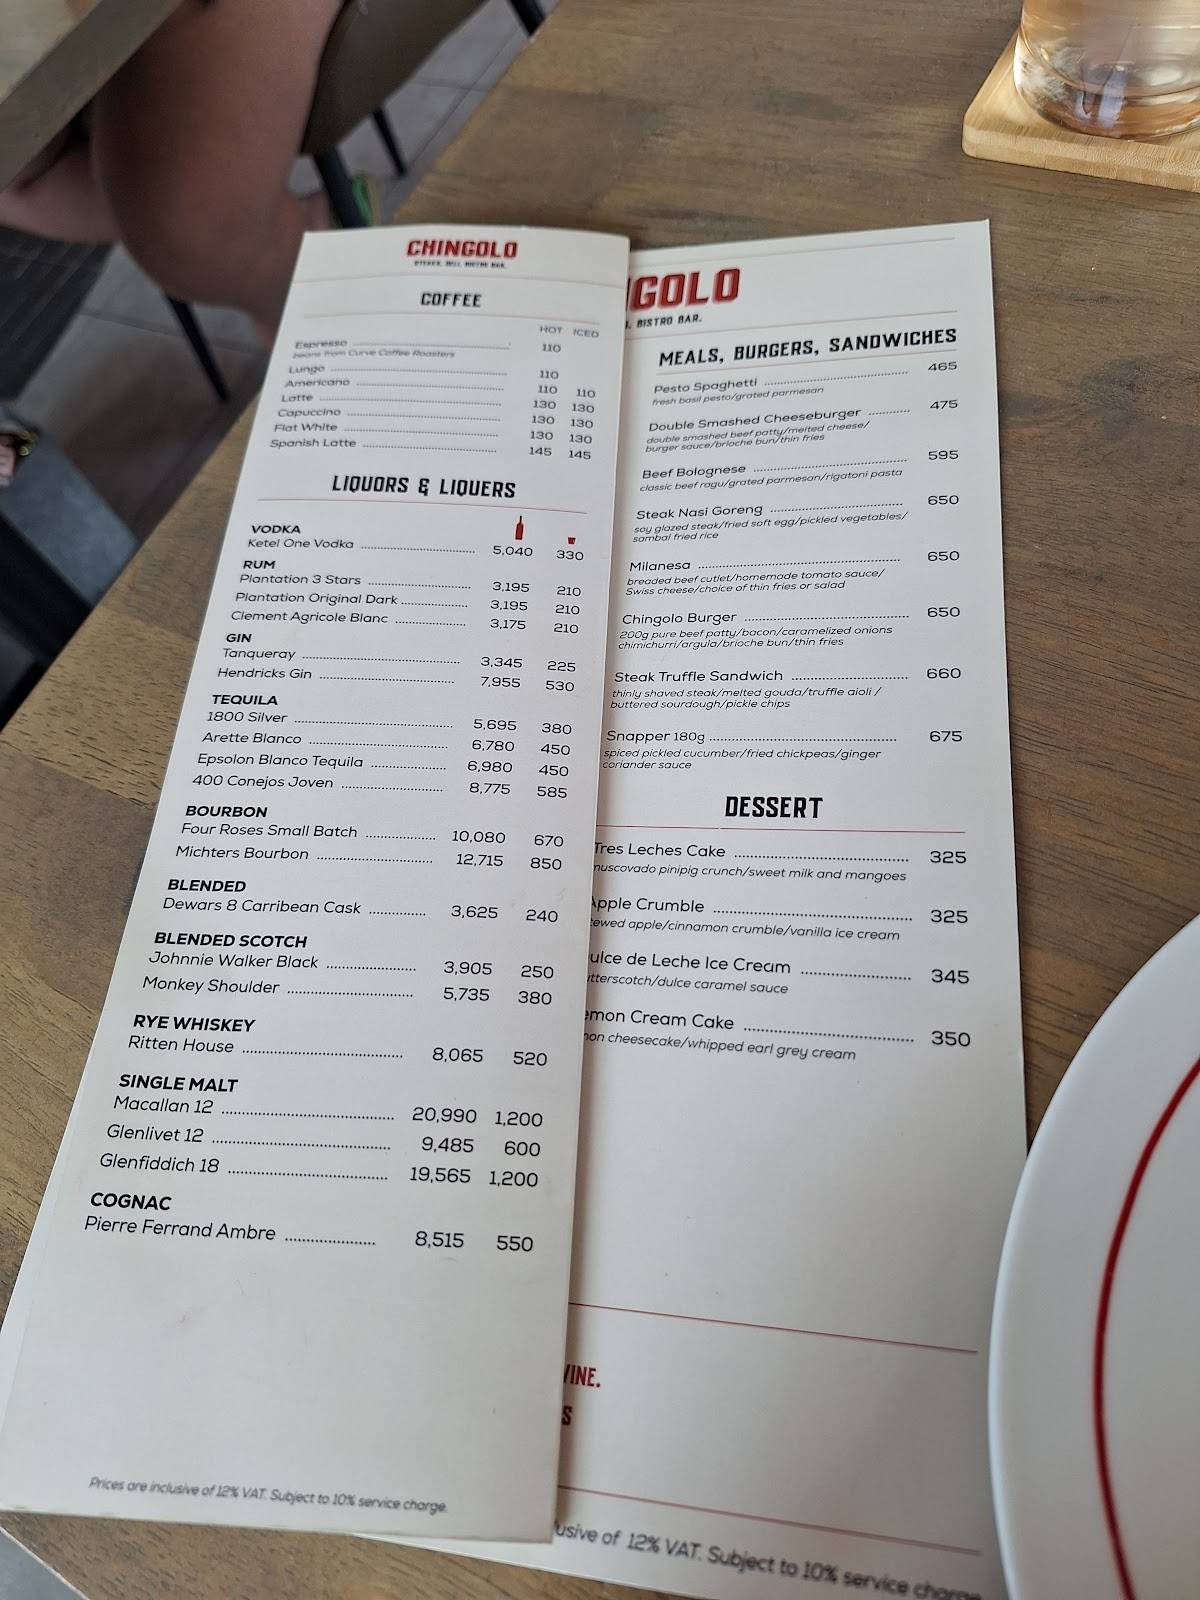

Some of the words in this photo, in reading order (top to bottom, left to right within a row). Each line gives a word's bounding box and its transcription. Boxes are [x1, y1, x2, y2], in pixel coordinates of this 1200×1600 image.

[406, 239, 519, 260] CHINGOLO
[420, 292, 482, 308] COFFEE
[625, 266, 741, 313] GOLO
[538, 324, 564, 335] HOT
[572, 327, 600, 339] ICED
[635, 315, 674, 329] BISTRO
[677, 313, 703, 325] BAR.
[294, 339, 349, 351] Espresso
[541, 343, 562, 354] 110
[658, 347, 725, 367] MEALS,
[733, 339, 820, 361] BURGERS,
[828, 327, 957, 353] SANDWICHES
[287, 364, 326, 376] Lungo
[539, 369, 560, 380] 110
[653, 384, 691, 395] Pesto
[692, 377, 758, 394] Spaghetti
[927, 360, 958, 372] 465
[276, 407, 342, 419] Capuccino
[531, 414, 556, 425] 130
[570, 418, 594, 430] 130
[648, 420, 695, 433] Double
[697, 415, 761, 429] Smashed
[763, 409, 863, 425] Cheeseburger
[929, 398, 959, 410] 475
[273, 423, 299, 433] Flat
[300, 422, 339, 432] White
[530, 429, 555, 441] 130
[568, 433, 593, 445] 130
[641, 468, 675, 480] Beef
[675, 465, 747, 479] Bolognese
[927, 449, 960, 461] 595
[331, 474, 410, 494] LIQUORS
[417, 477, 431, 497] &
[438, 477, 517, 499] LIQUERS
[635, 508, 675, 521] Steak
[677, 506, 709, 518] Nasi
[711, 505, 763, 518] Goreng
[927, 494, 960, 506] 650
[251, 524, 302, 535] VODKA
[631, 532, 673, 543] sambal
[672, 531, 699, 542] fried
[698, 530, 720, 540] rice
[247, 538, 281, 549] Ketel
[282, 538, 312, 549] One
[313, 538, 355, 550] Vodka
[492, 544, 534, 558] 5,040
[555, 549, 585, 562] 330
[629, 560, 692, 573] Milanesa
[926, 549, 960, 563] 650
[242, 559, 277, 570] RUM
[239, 573, 309, 585] Plantation
[311, 573, 323, 585] 3
[323, 574, 362, 586] Stars
[491, 580, 530, 594] 3,195
[556, 585, 582, 598] 210
[624, 586, 656, 597] Swiss
[656, 584, 734, 596] cheese/choice
[734, 582, 749, 593] of
[748, 582, 771, 592] thin
[772, 581, 797, 591] fries
[798, 582, 813, 591] or
[813, 579, 847, 590] salad
[621, 612, 684, 628] Chingolo
[687, 612, 738, 627] Burger
[926, 605, 961, 619] 650
[225, 632, 253, 644] GIN
[222, 647, 297, 662] Tanqueray
[480, 655, 523, 669] 3,345
[546, 660, 577, 673] 225
[613, 671, 656, 683] Steak
[658, 670, 706, 683] Truffle
[709, 669, 784, 682] Sandwich
[926, 667, 962, 680] 660
[211, 693, 279, 706] TEQUILA
[206, 710, 245, 723] 1800
[246, 710, 289, 724] Silver
[473, 718, 518, 732] 5,695
[541, 721, 573, 735] 380
[201, 731, 250, 744] Arette
[252, 731, 303, 745] Blanco
[471, 739, 515, 753] 6,780
[540, 743, 572, 757] 450
[605, 728, 671, 745] Snapper
[673, 731, 706, 746] 180g
[929, 729, 964, 743] 675
[601, 759, 658, 771] coriander
[657, 761, 693, 770] sauce
[185, 804, 269, 819] BOURBON
[724, 795, 824, 820] DESSERT
[180, 821, 218, 835] Four
[218, 822, 264, 837] Roses
[266, 823, 311, 837] Small
[312, 824, 358, 838] Batch
[451, 829, 506, 845] 10,080
[533, 834, 565, 848] 670
[594, 841, 625, 855] Tres
[627, 842, 683, 857] Leches
[686, 843, 727, 858] Cake
[929, 850, 968, 865] 325
[167, 878, 247, 893] BLENDED
[162, 897, 223, 912] Dewars
[225, 898, 238, 912] 8
[241, 898, 320, 914] Carribean
[323, 900, 362, 915] Cask
[450, 904, 499, 920] 3,625
[525, 908, 559, 924] 240
[635, 896, 705, 914] Crumble
[930, 908, 969, 925] 325
[153, 931, 236, 948] BLENDED
[238, 934, 309, 949] SCOTCH
[148, 950, 215, 967] Johnnie
[218, 953, 274, 968] Walker
[275, 954, 319, 969] Black
[443, 960, 493, 976] 3,905
[520, 964, 555, 980] 250
[132, 1013, 170, 1030] RYE
[172, 1016, 257, 1033] WHISKEY
[127, 1035, 179, 1052] Ritten
[182, 1037, 235, 1054] House
[431, 1046, 484, 1064] 8,065
[512, 1051, 548, 1067] 520
[117, 1073, 187, 1091] SINGLE
[187, 1077, 240, 1093] MALT
[112, 1094, 191, 1114] Macallan
[193, 1099, 215, 1115] 12
[411, 1106, 478, 1124] 20,990
[494, 1110, 544, 1128] 1,200
[99, 1152, 196, 1173] Glenfiddich
[198, 1157, 221, 1174] 18
[409, 1165, 472, 1185] 19,565
[488, 1170, 539, 1189] 1,200
[89, 1191, 173, 1212] COGNAC
[83, 1214, 138, 1234] Pierre
[141, 1218, 214, 1238] Ferrand
[214, 1222, 277, 1242] Ambre
[414, 1230, 465, 1249] 8,515
[496, 1234, 534, 1253] 550
[88, 1475, 126, 1492] Prices
[125, 1481, 149, 1493] are
[148, 1482, 201, 1497] inclusive
[200, 1483, 216, 1497] of
[269, 1488, 316, 1506] Subject
[316, 1493, 331, 1506] to
[357, 1496, 402, 1511] service
